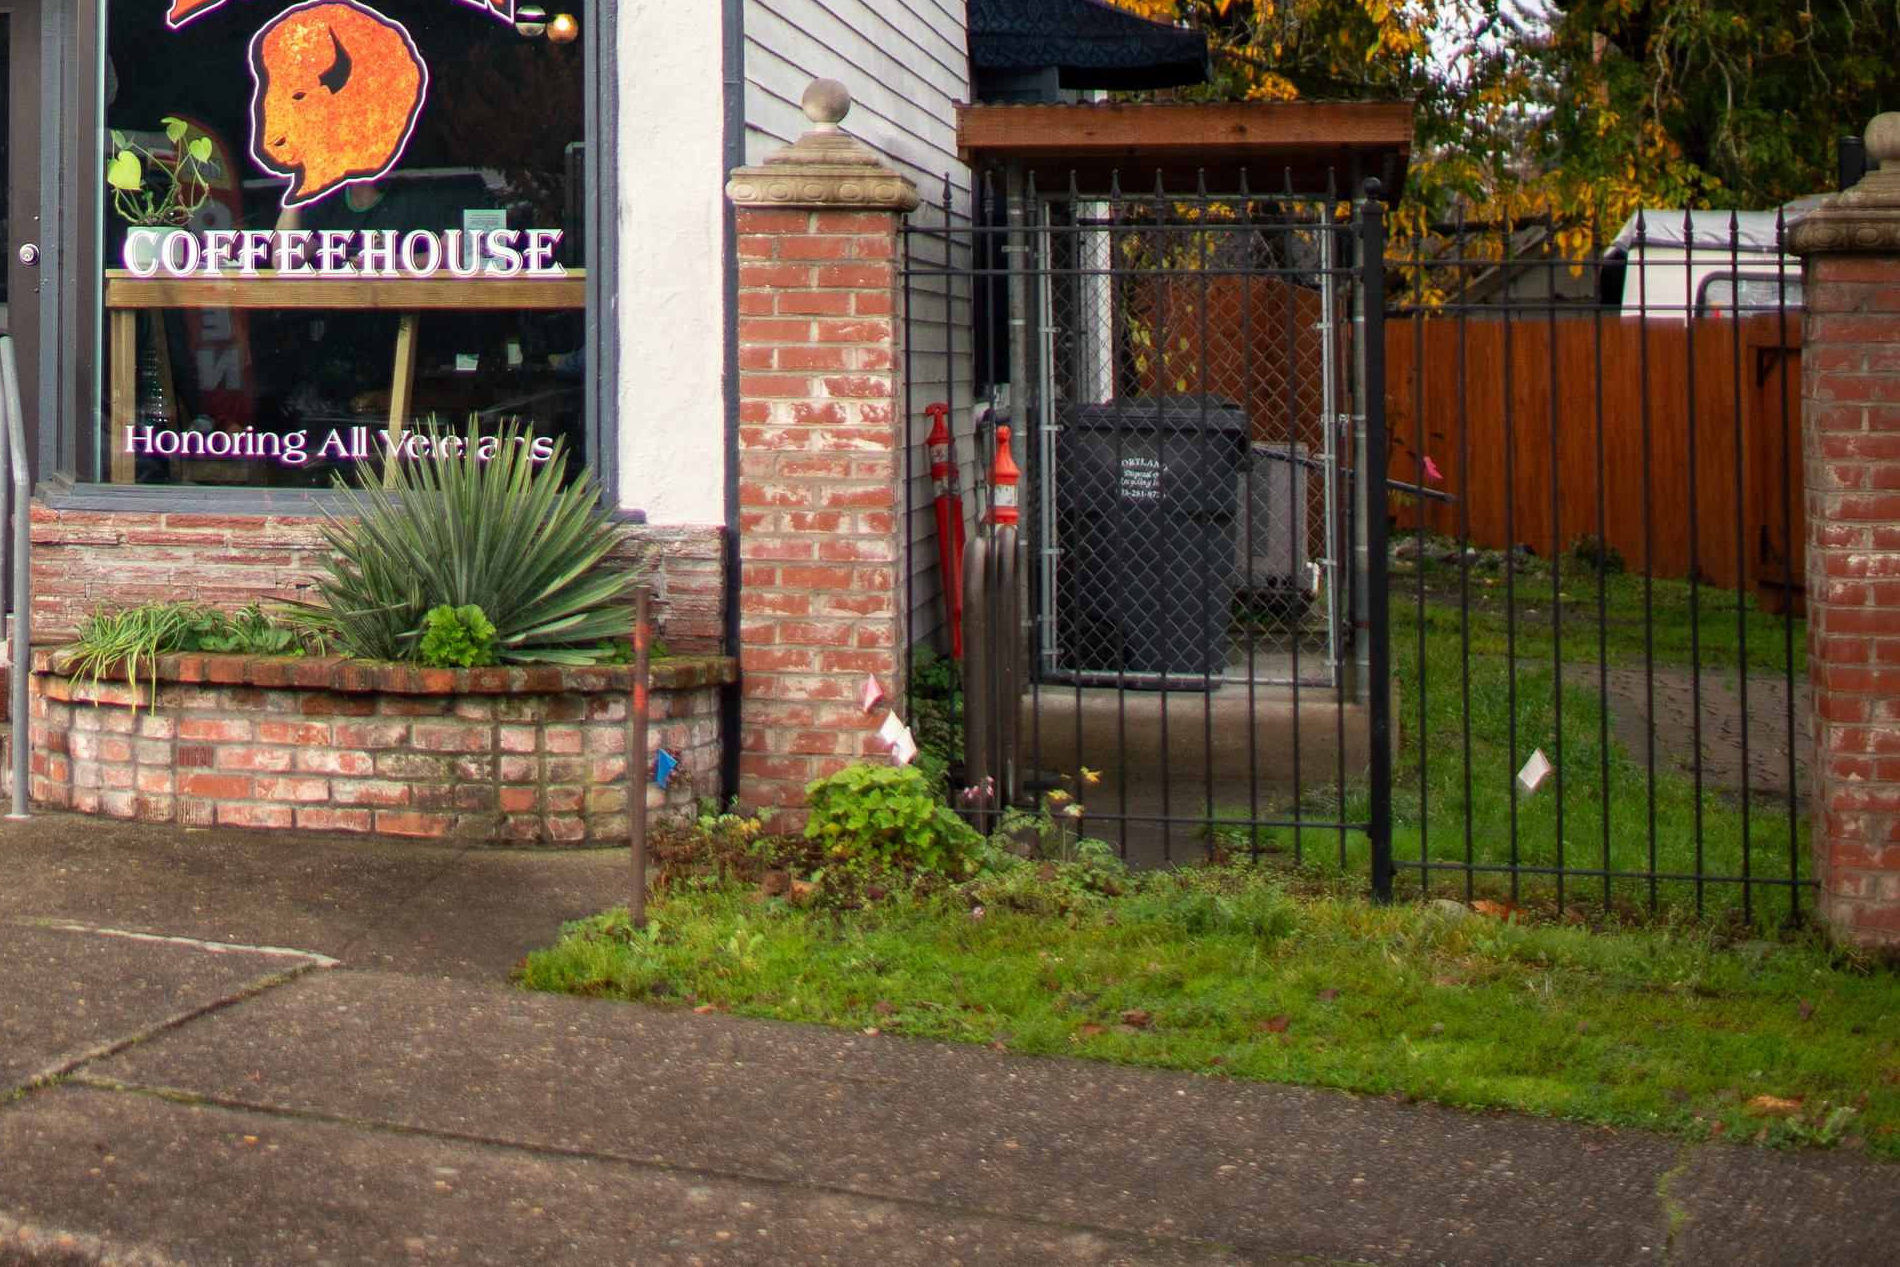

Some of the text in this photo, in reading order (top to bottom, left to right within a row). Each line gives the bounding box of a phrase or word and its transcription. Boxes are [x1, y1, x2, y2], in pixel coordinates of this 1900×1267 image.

[123, 228, 567, 277] COFFEEHOUSE
[125, 425, 307, 463] Honoring
[317, 425, 368, 457] All
